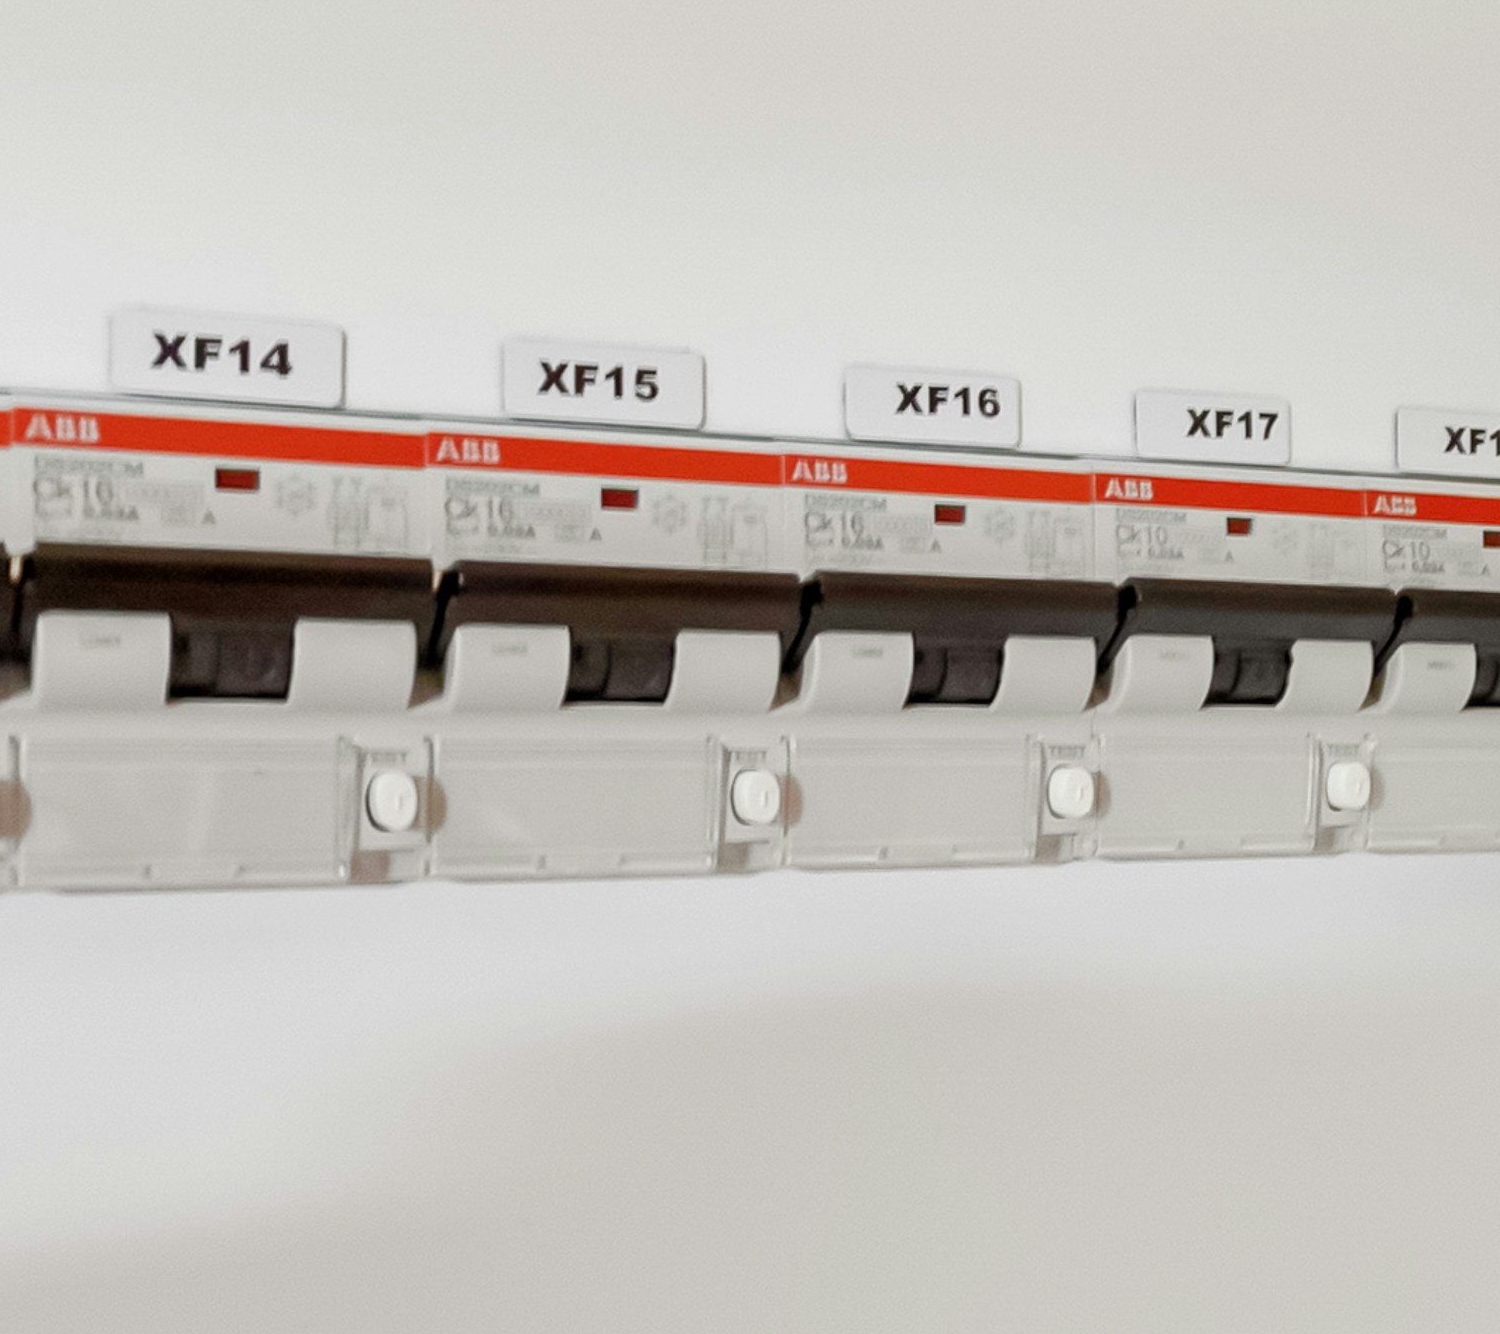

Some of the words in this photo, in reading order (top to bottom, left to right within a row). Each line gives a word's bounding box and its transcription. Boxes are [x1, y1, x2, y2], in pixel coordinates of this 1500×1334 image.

[152, 333, 293, 377] XF14
[538, 361, 659, 402] XF15
[896, 383, 1001, 419] XF16
[24, 412, 99, 443] ABB
[1187, 408, 1279, 441] XF17
[436, 435, 501, 465] ABB
[791, 459, 848, 485] ABB
[1104, 477, 1154, 500] ABB
[1372, 494, 1417, 516] ABB
